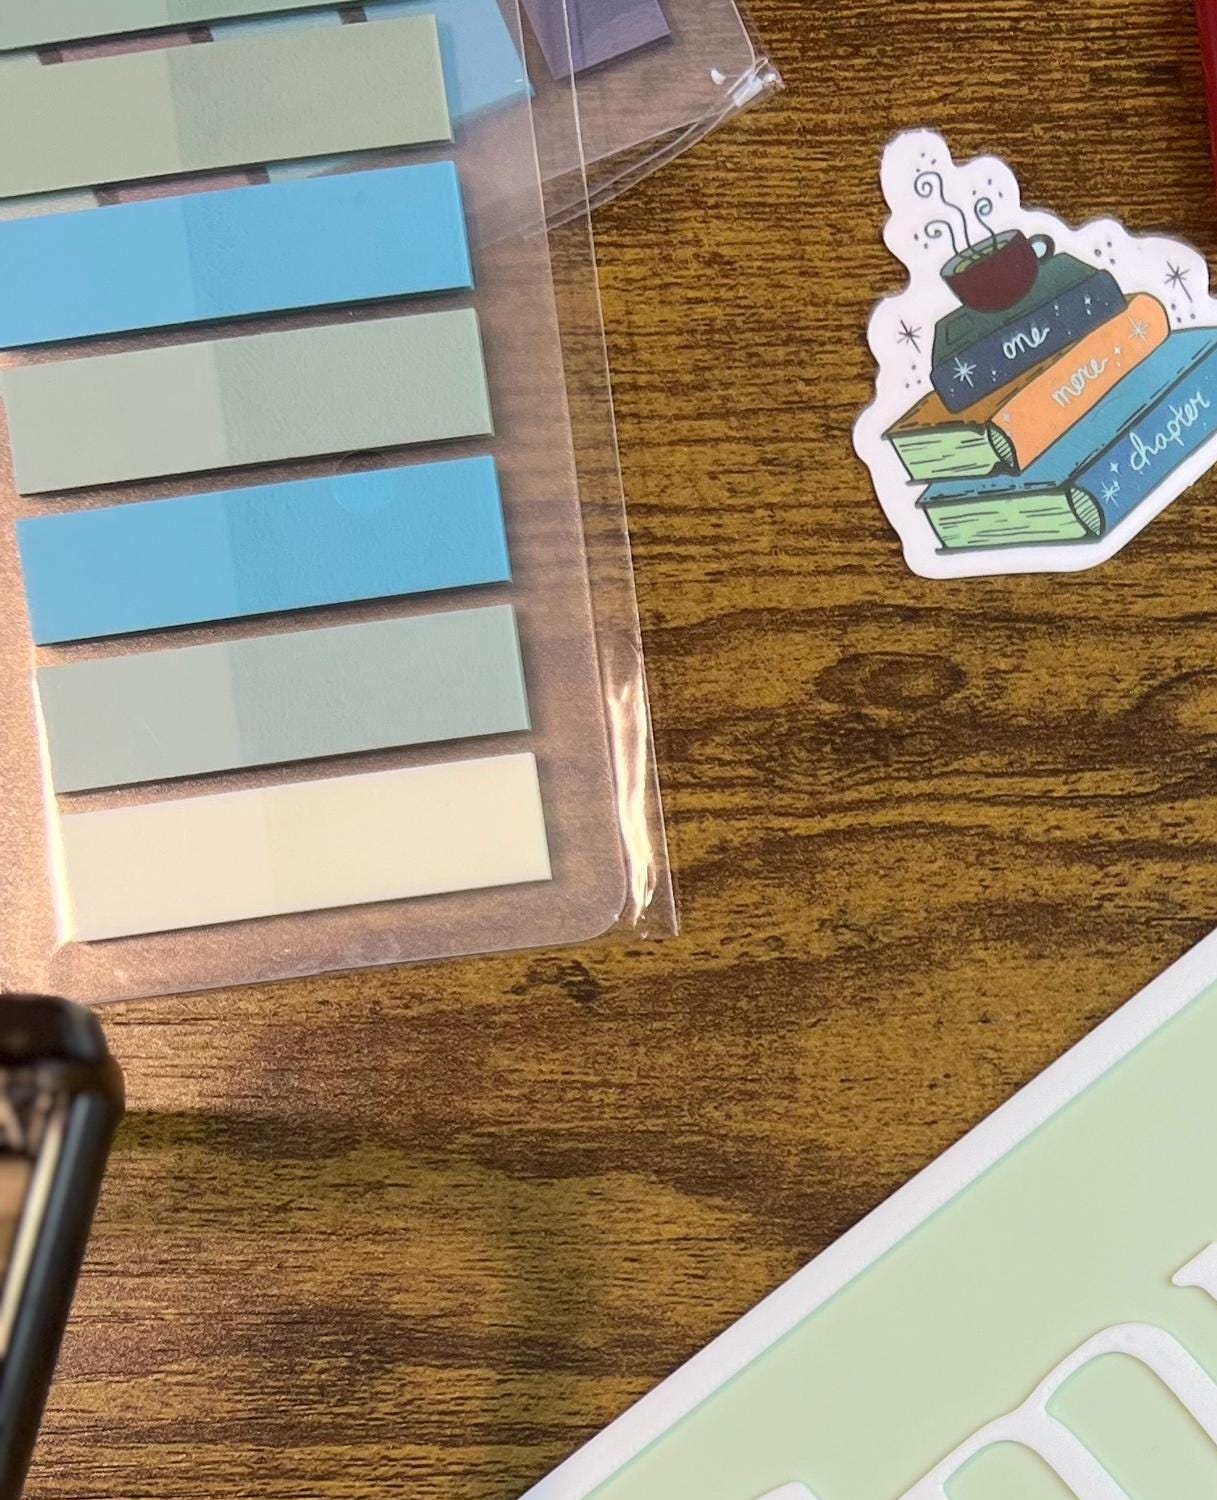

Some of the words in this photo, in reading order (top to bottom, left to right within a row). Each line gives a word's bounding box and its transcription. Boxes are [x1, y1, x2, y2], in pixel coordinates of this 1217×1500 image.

[1002, 326, 1051, 360] one
[1051, 356, 1109, 408] more
[1129, 390, 1211, 472] chapter
